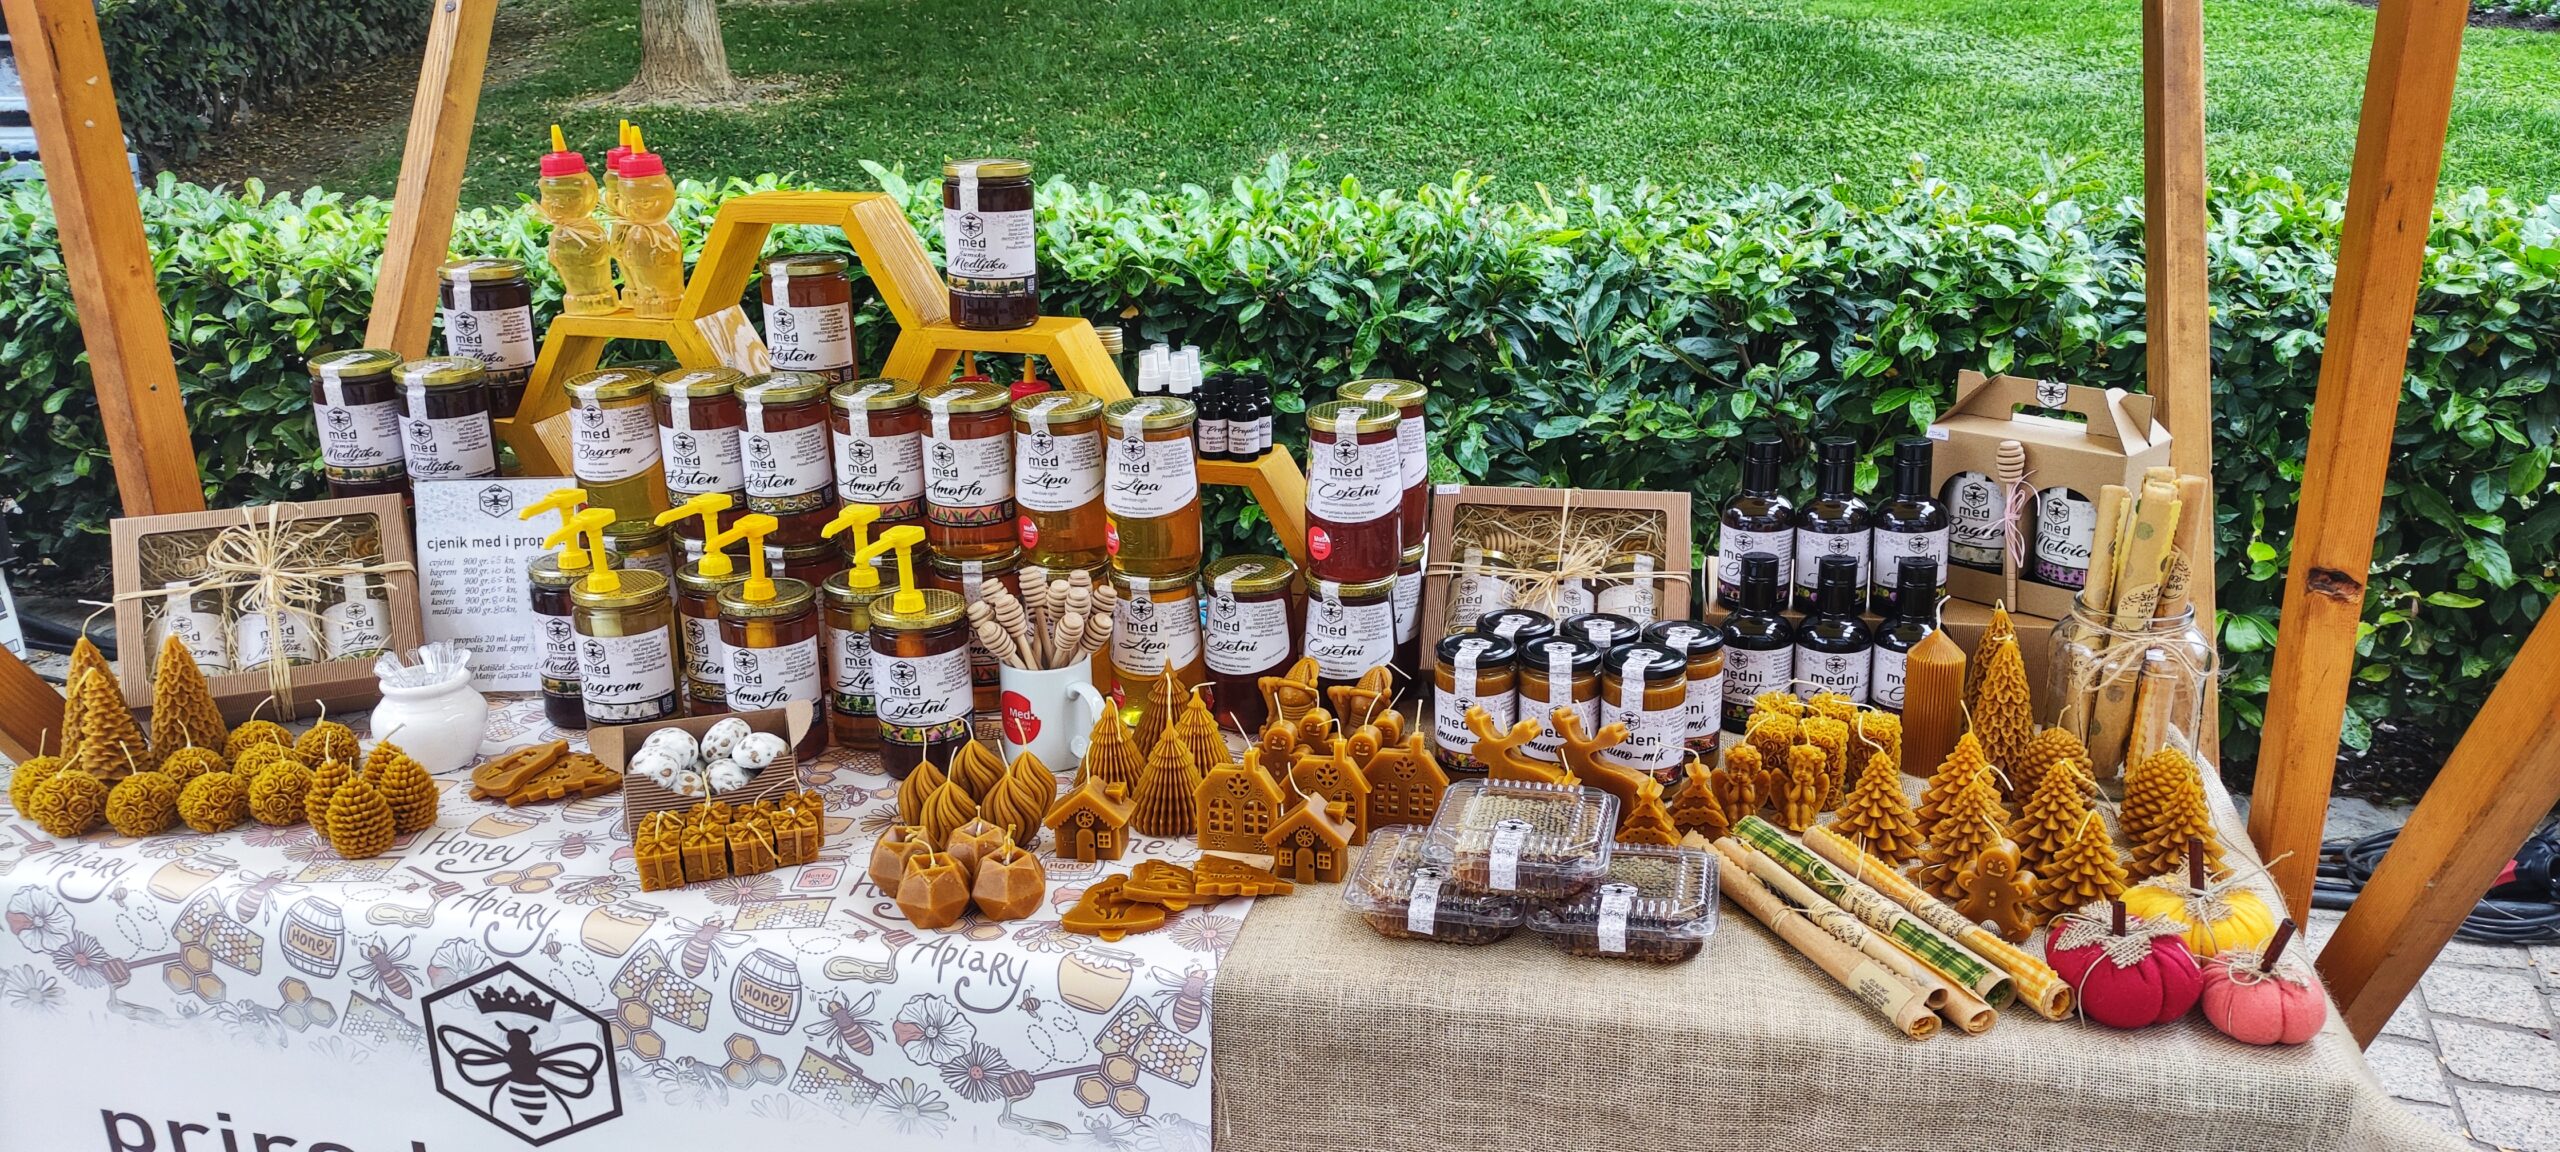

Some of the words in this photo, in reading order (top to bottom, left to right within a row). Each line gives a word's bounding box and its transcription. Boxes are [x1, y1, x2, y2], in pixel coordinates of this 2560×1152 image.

[959, 238, 986, 248] med
[456, 334, 482, 344] med
[774, 332, 798, 342] med
[329, 430, 357, 439] med
[581, 428, 610, 439] med
[411, 443, 437, 452] med
[673, 455, 700, 466] med
[750, 458, 776, 469] med
[1029, 456, 1058, 467] med
[849, 464, 877, 474] med
[932, 467, 959, 478] med
[1119, 462, 1150, 472] med
[1330, 465, 1363, 476] med
[1022, 472, 1071, 489] Lipa
[1112, 478, 1162, 495] Lipa
[1959, 506, 1990, 519] med
[1949, 515, 2005, 540] Bagre
[2044, 521, 2071, 536] med
[427, 536, 468, 552] cjenik
[472, 535, 501, 548] med
[1456, 595, 1483, 605] med
[1628, 605, 1658, 617] med
[1127, 622, 1158, 632] med
[1213, 619, 1240, 632] med
[1317, 624, 1347, 636] med
[453, 635, 483, 646] propolis
[484, 635, 495, 643] 20
[547, 642, 576, 651] med
[686, 642, 708, 654] med
[584, 664, 611, 675] med
[734, 674, 762, 684] med
[1811, 672, 1859, 686] medni
[890, 686, 920, 696] med
[291, 927, 333, 956] Honey
[743, 984, 789, 1012] Honey
